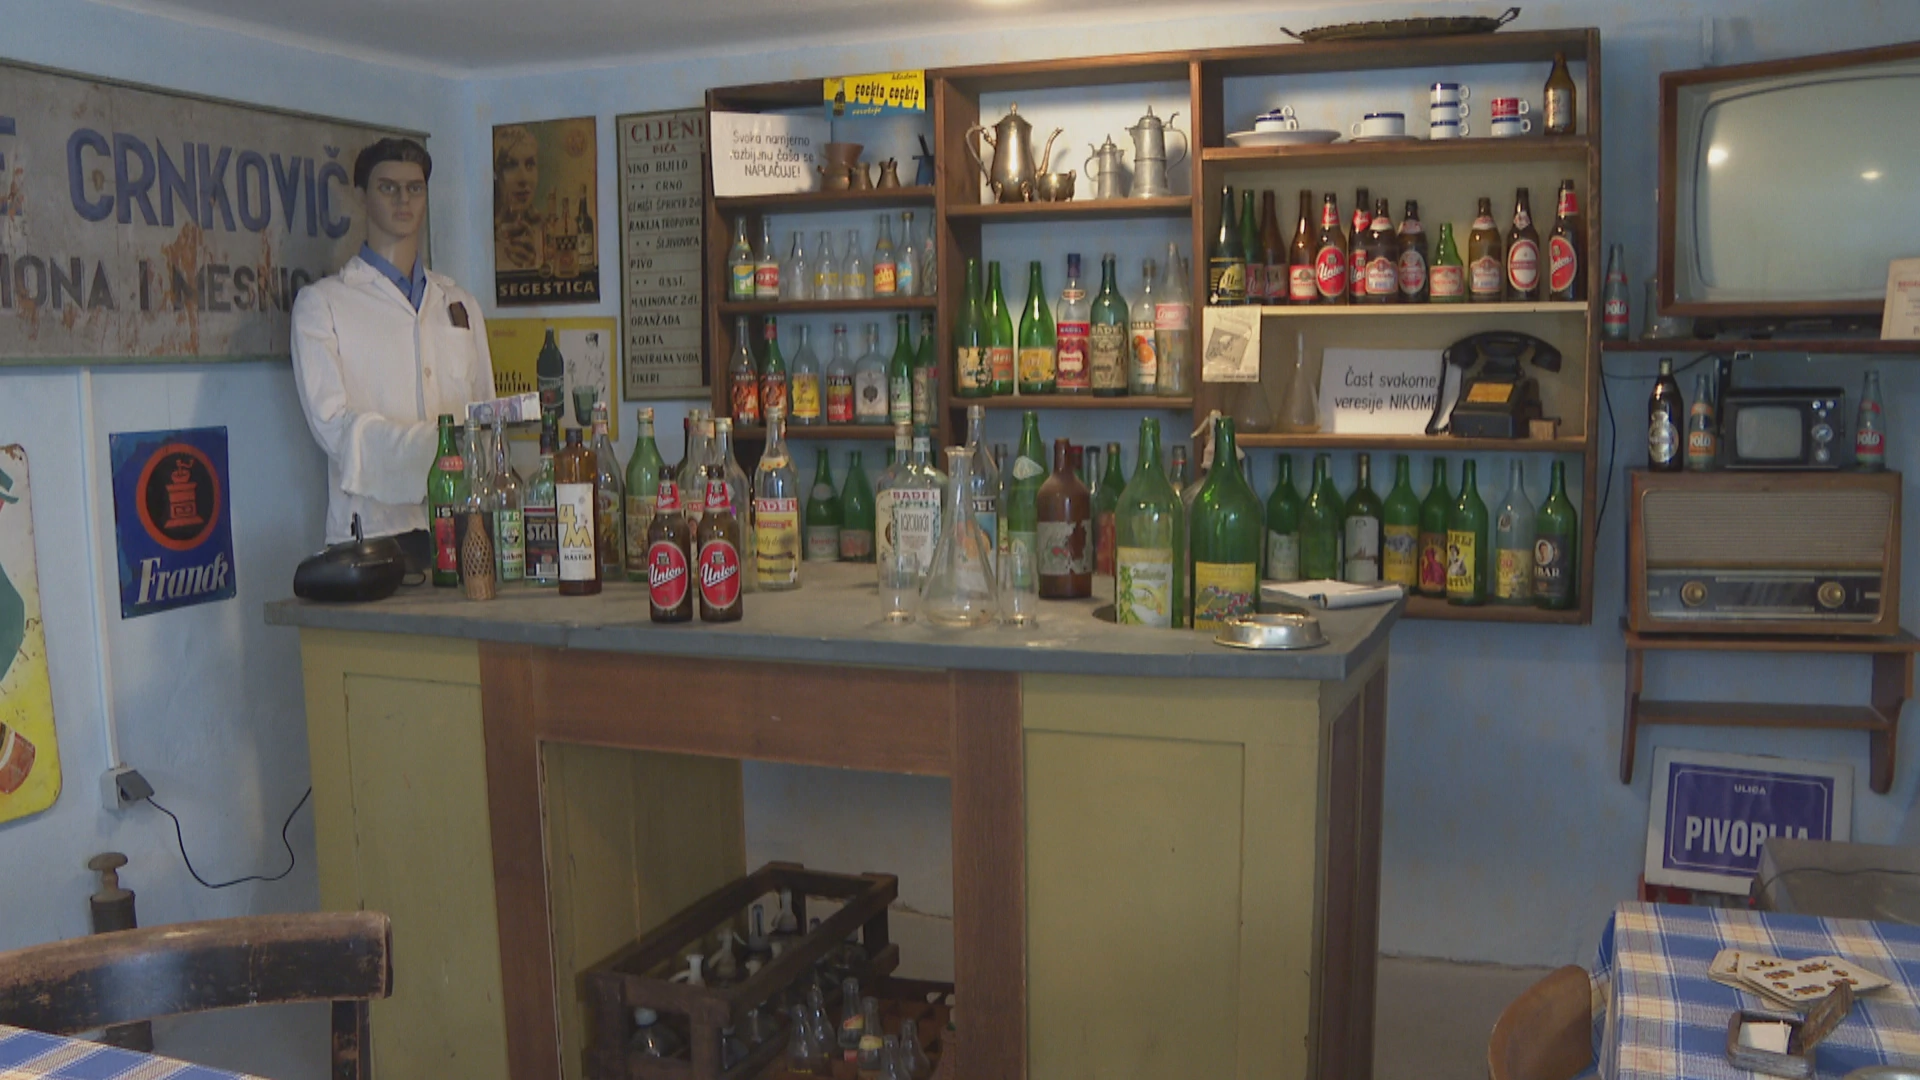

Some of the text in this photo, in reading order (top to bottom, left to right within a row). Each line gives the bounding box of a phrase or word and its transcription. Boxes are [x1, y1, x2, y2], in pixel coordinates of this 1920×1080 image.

[765, 133, 810, 149] namjerno
[803, 154, 814, 163] se
[628, 162, 649, 174] VINO
[66, 128, 351, 239] CRNKOVIČ
[655, 180, 682, 191] CRNO
[629, 219, 660, 232] RAKIJA
[630, 259, 653, 270] PIVO
[500, 280, 595, 297] SEGESTICA
[631, 295, 678, 308] MALINOVAC
[631, 313, 680, 327] ORANŽADA
[631, 352, 700, 365] MINERALNA VODA
[632, 372, 660, 384] LIKERI
[1344, 366, 1437, 389] Čast svakome
[1334, 394, 1384, 414] veresije
[892, 491, 937, 501] BADEL
[757, 500, 797, 511] ADEL
[564, 553, 592, 561] MASTIKA
[135, 552, 229, 604] Franck
[648, 563, 685, 588] Union
[700, 563, 738, 588] Union
[1733, 784, 1767, 795] ULICA
